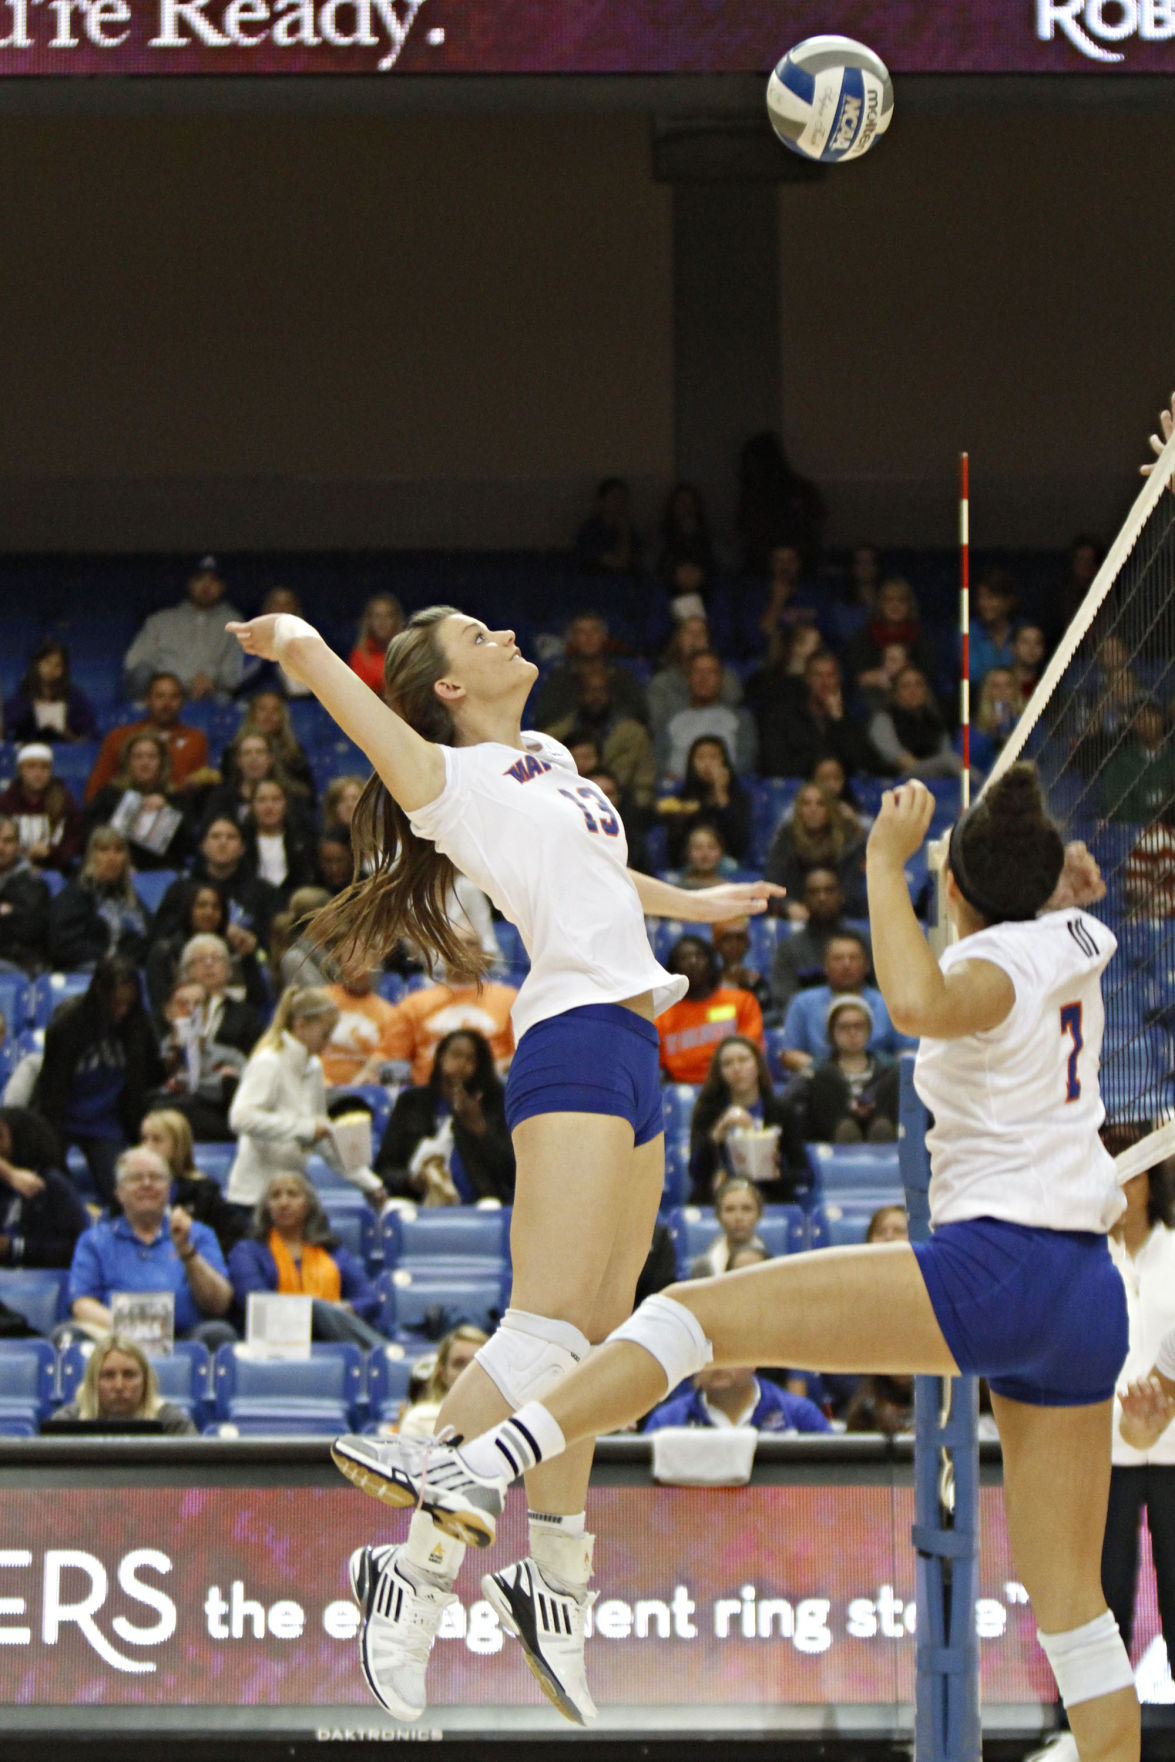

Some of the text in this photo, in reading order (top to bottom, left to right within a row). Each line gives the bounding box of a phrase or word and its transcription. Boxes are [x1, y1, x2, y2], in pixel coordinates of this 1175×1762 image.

[148, 0, 445, 71] Ready.
[829, 93, 862, 151] NCAA
[557, 787, 620, 837] 13
[1060, 1000, 1084, 1104] 7
[205, 1581, 305, 1639] the
[714, 1585, 832, 1653] ring
[316, 1728, 443, 1741] DAKTRONICS
